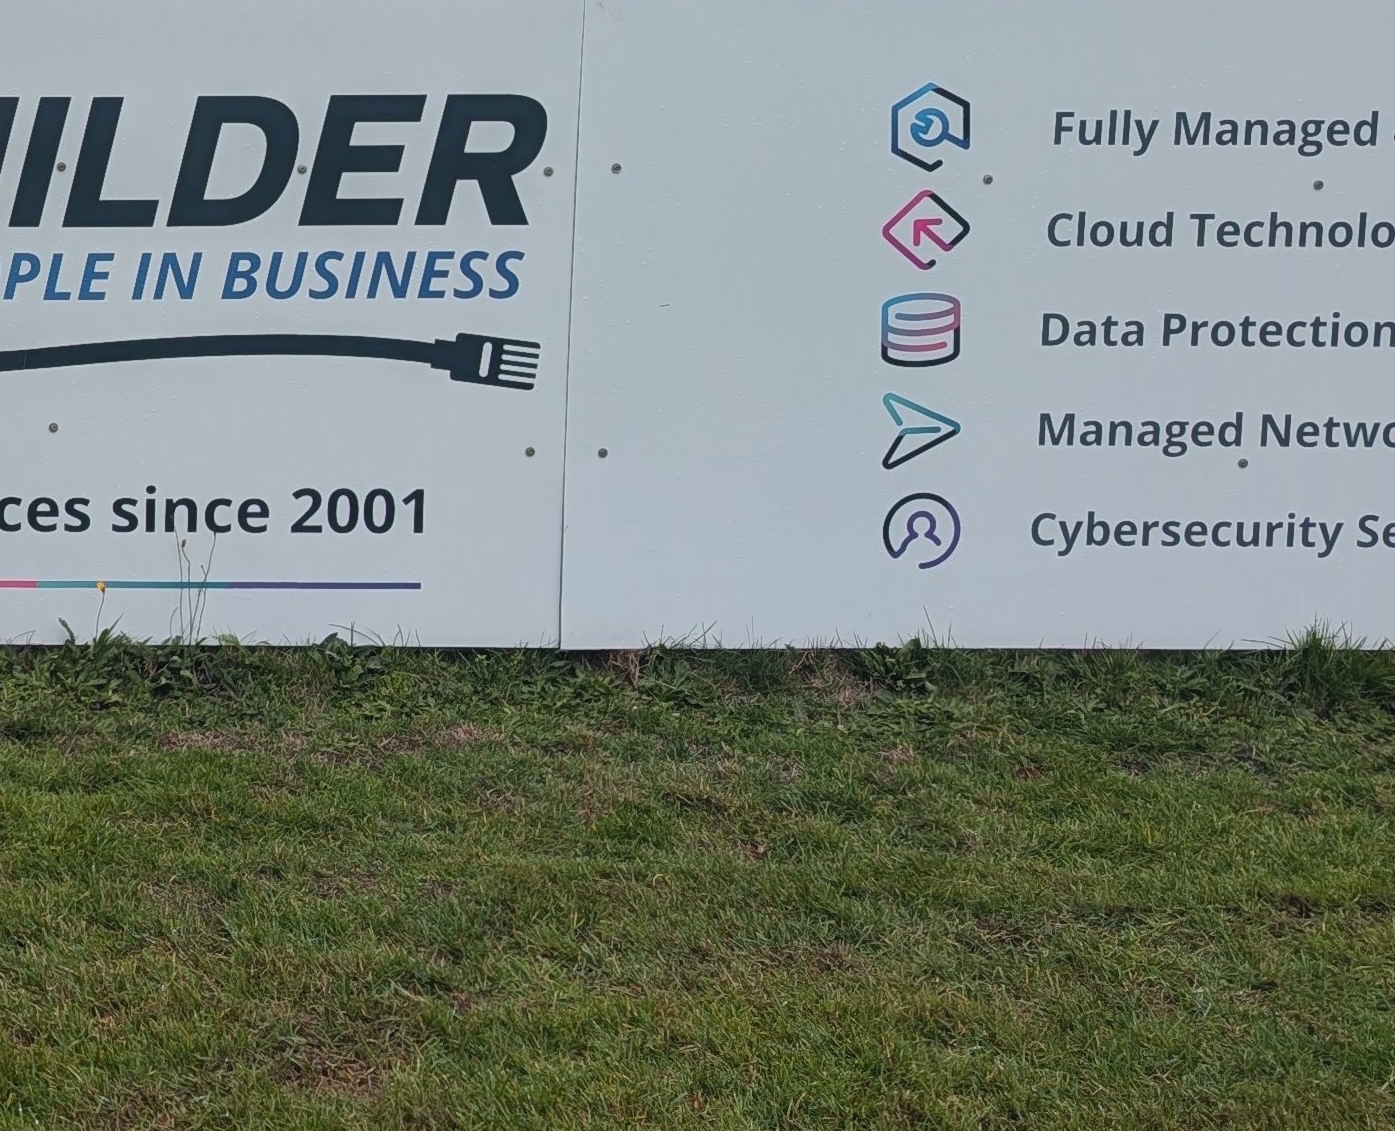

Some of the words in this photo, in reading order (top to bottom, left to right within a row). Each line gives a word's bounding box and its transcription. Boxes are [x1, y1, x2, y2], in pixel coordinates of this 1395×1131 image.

[1054, 110, 1159, 156] Fully
[1174, 111, 1379, 156] Managed
[1048, 212, 1174, 247] Cloud
[1190, 212, 1395, 248] Technolo
[132, 252, 202, 300] IN
[221, 251, 525, 299] BUSINESS
[1042, 314, 1144, 346] Data
[1163, 312, 1395, 347] Protection
[1039, 412, 1243, 457] Managed
[112, 485, 269, 533] since
[291, 488, 424, 533] 2001
[1032, 511, 1344, 558] Cybersecurity
